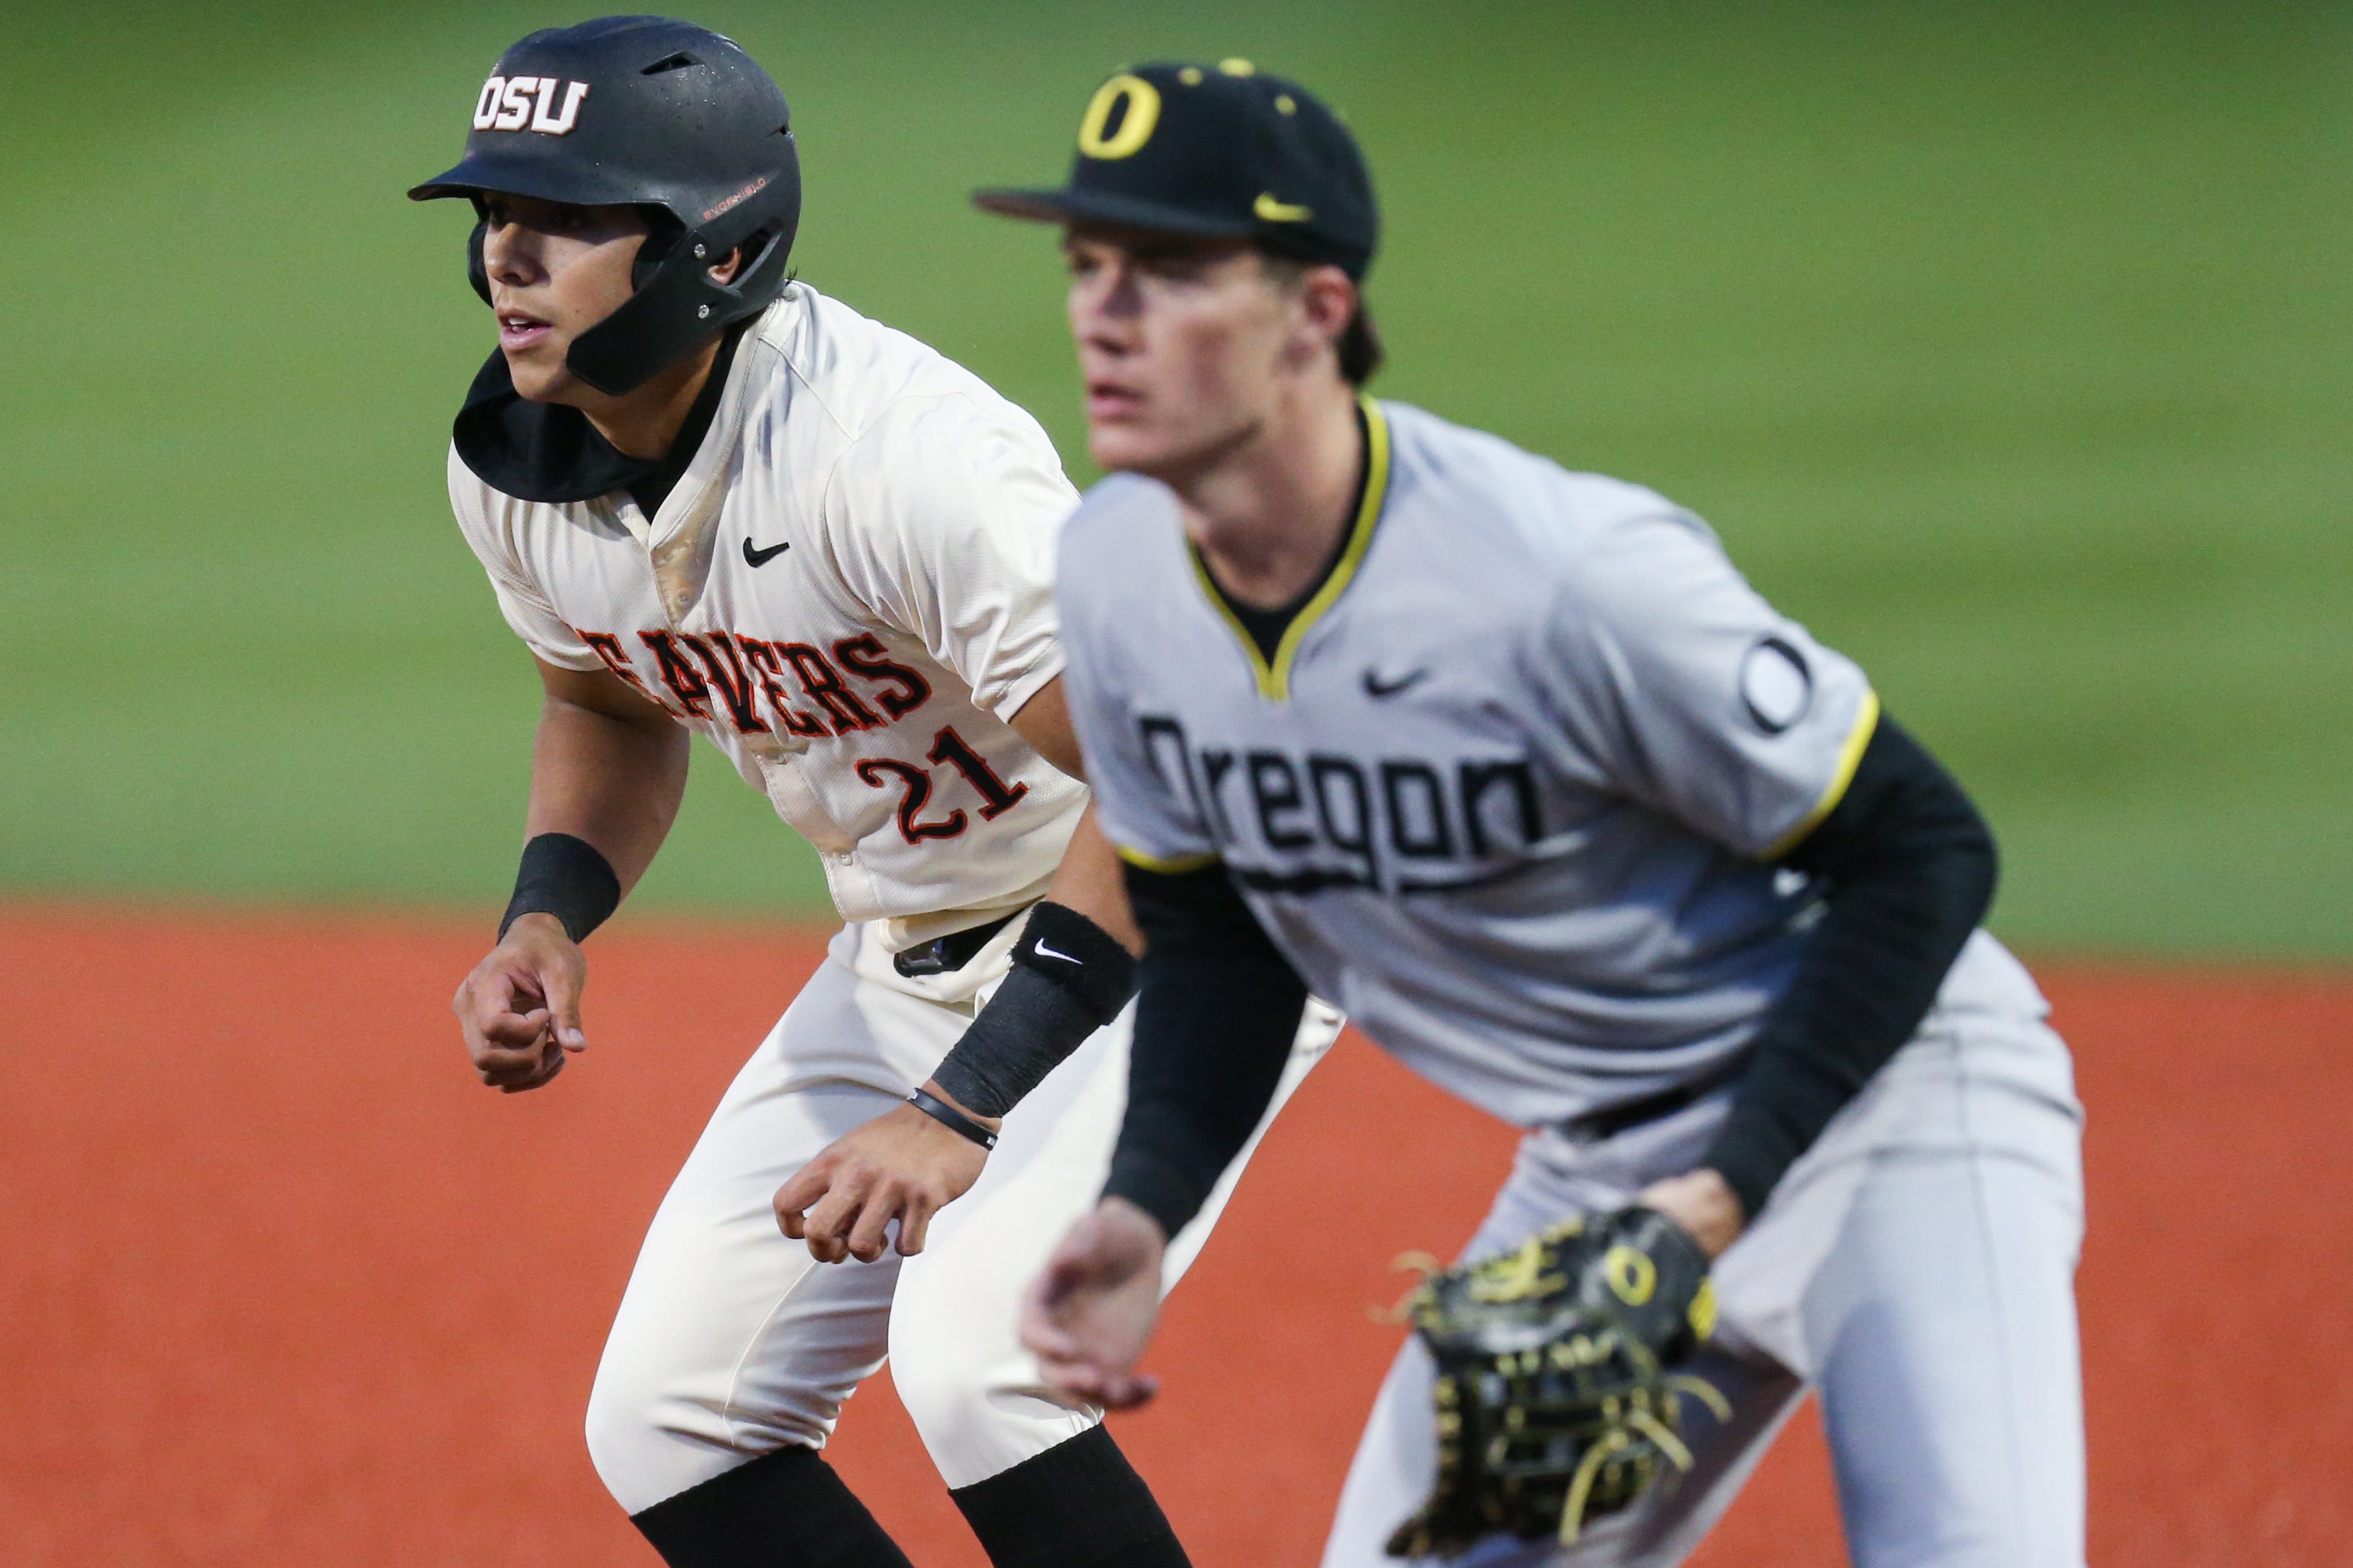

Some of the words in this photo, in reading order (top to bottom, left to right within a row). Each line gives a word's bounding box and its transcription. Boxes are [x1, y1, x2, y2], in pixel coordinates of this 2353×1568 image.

[473, 76, 590, 135] OSU
[1078, 74, 1161, 160] O
[576, 628, 932, 737] EAVERS
[854, 726, 1028, 845] 21
[1139, 716, 1544, 890] Oregon
